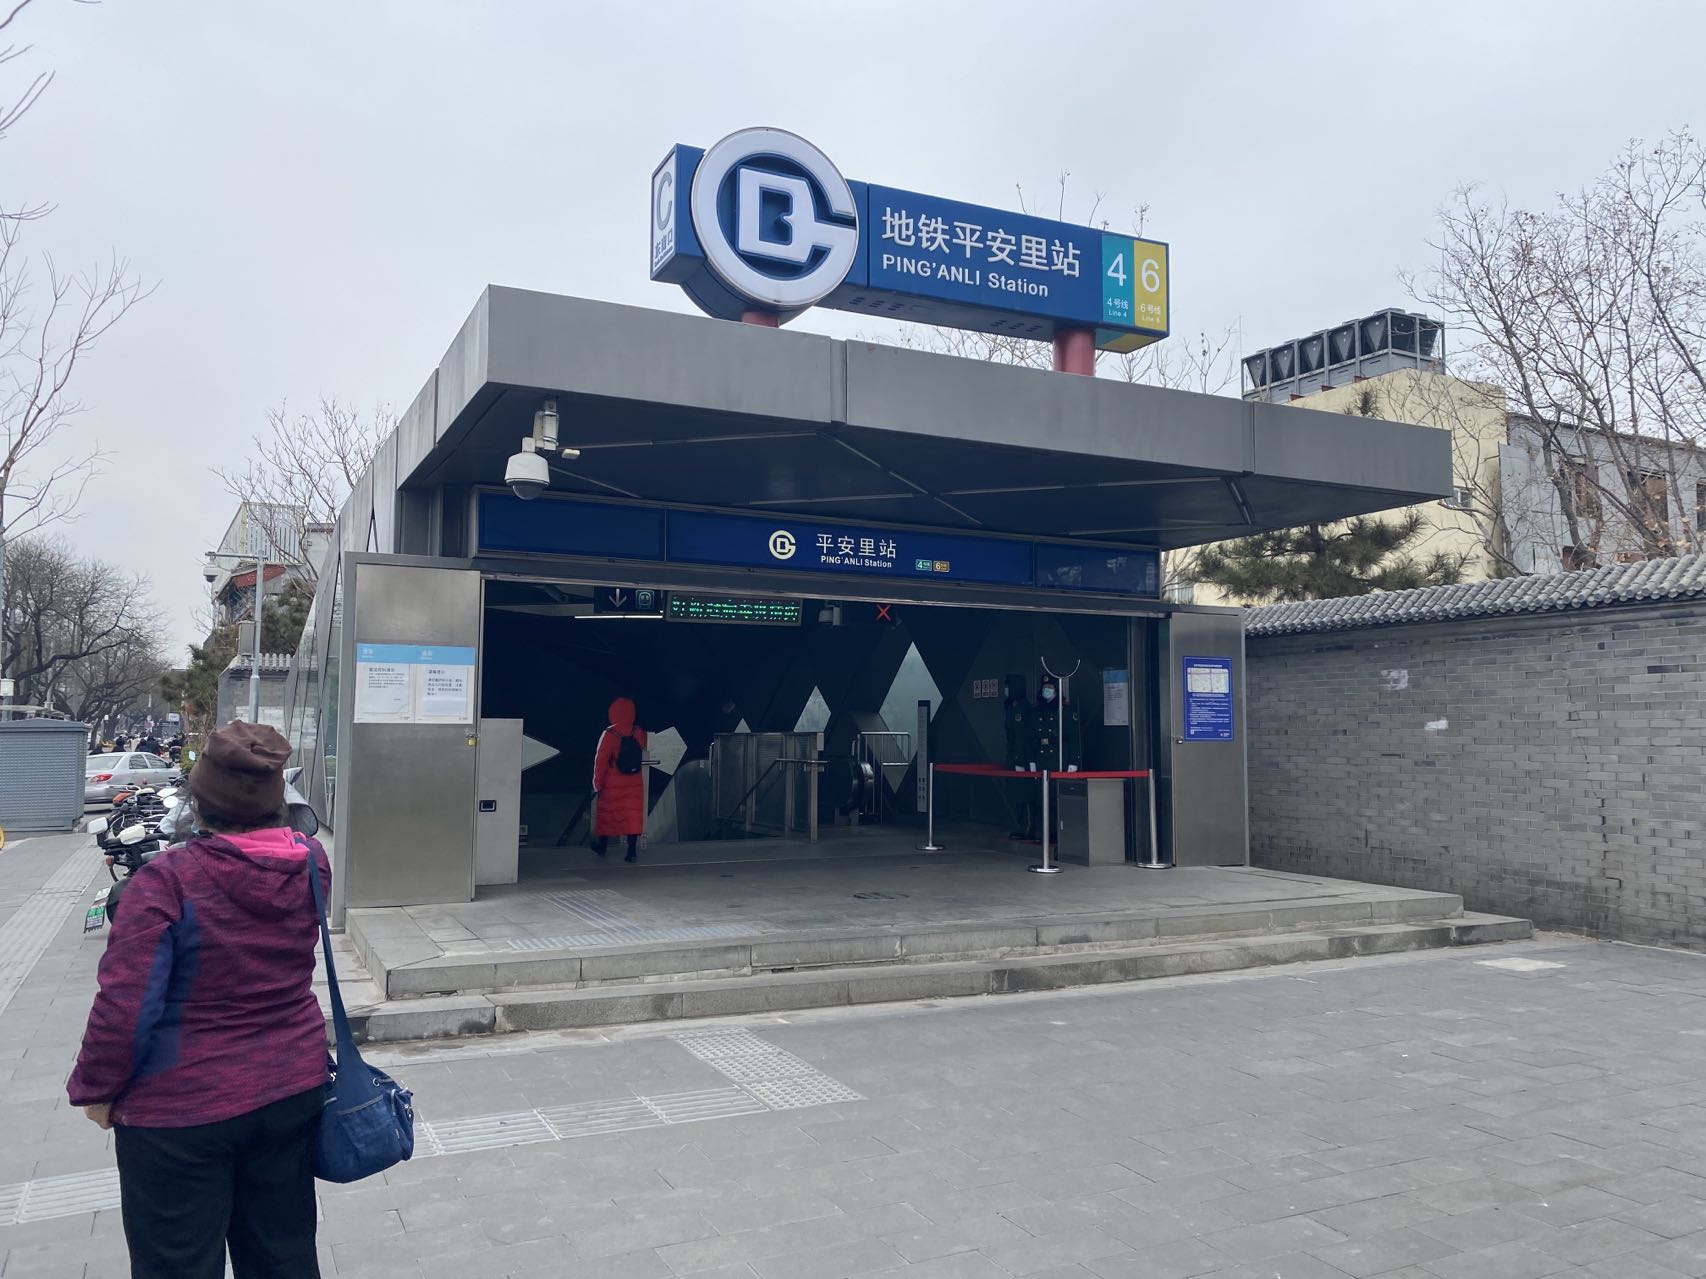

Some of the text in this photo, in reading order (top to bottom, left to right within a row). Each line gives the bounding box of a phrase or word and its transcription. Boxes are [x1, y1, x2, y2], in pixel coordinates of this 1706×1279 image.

[657, 171, 672, 230] C
[881, 206, 1081, 278] 地铁平安里站
[882, 254, 1049, 298] PING'ANLI Station
[1107, 253, 1127, 287] 4
[1141, 259, 1160, 293] 6
[815, 533, 897, 559] 平安里站
[820, 555, 892, 569] PING'ANLI Station
